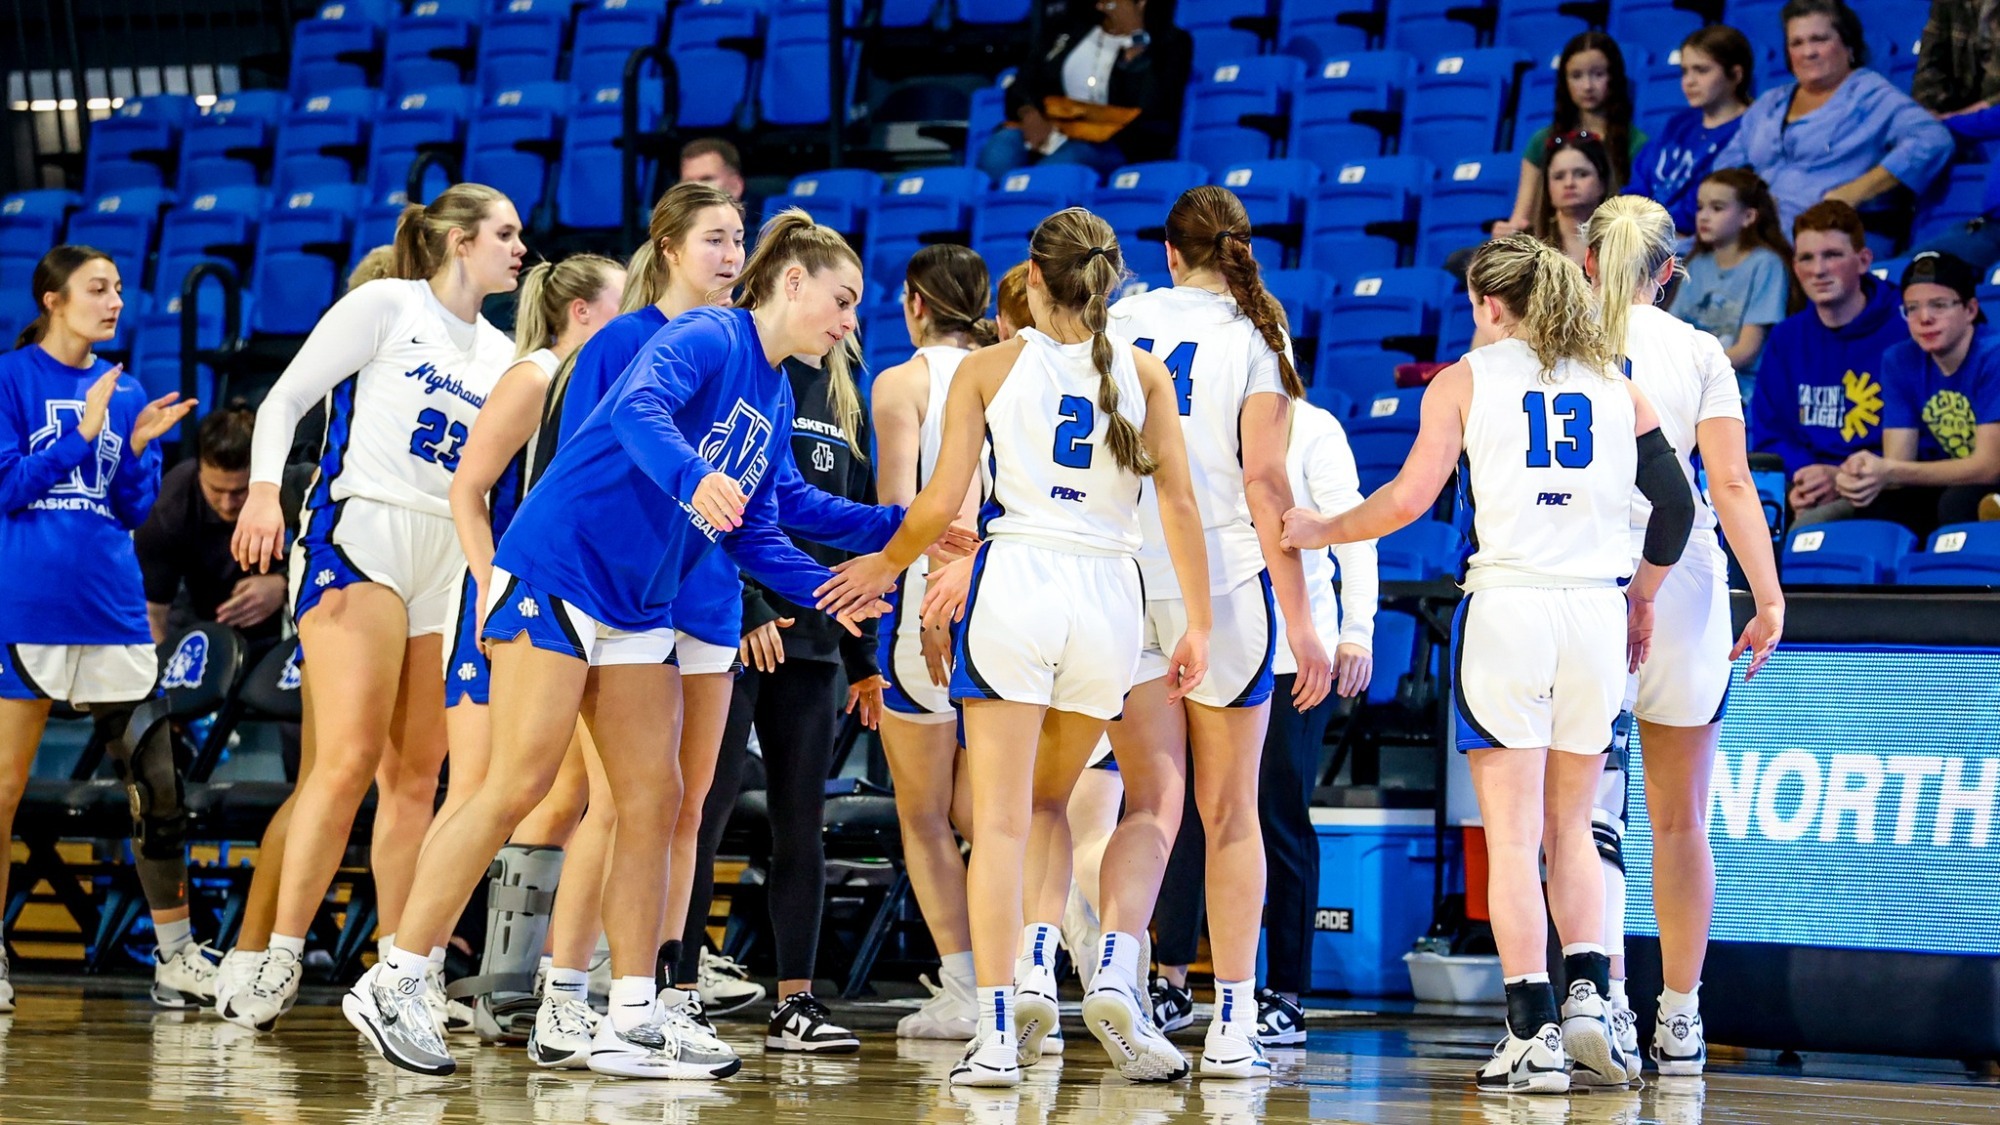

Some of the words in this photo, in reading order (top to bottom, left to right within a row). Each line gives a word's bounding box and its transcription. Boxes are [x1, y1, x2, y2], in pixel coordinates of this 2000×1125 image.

[409, 407, 468, 474] 23
[1053, 394, 1094, 469] 2
[1522, 391, 1593, 469] 13
[1050, 486, 1086, 502] PBC
[1536, 492, 1572, 506] PBC
[1705, 749, 2000, 848] NORTH
